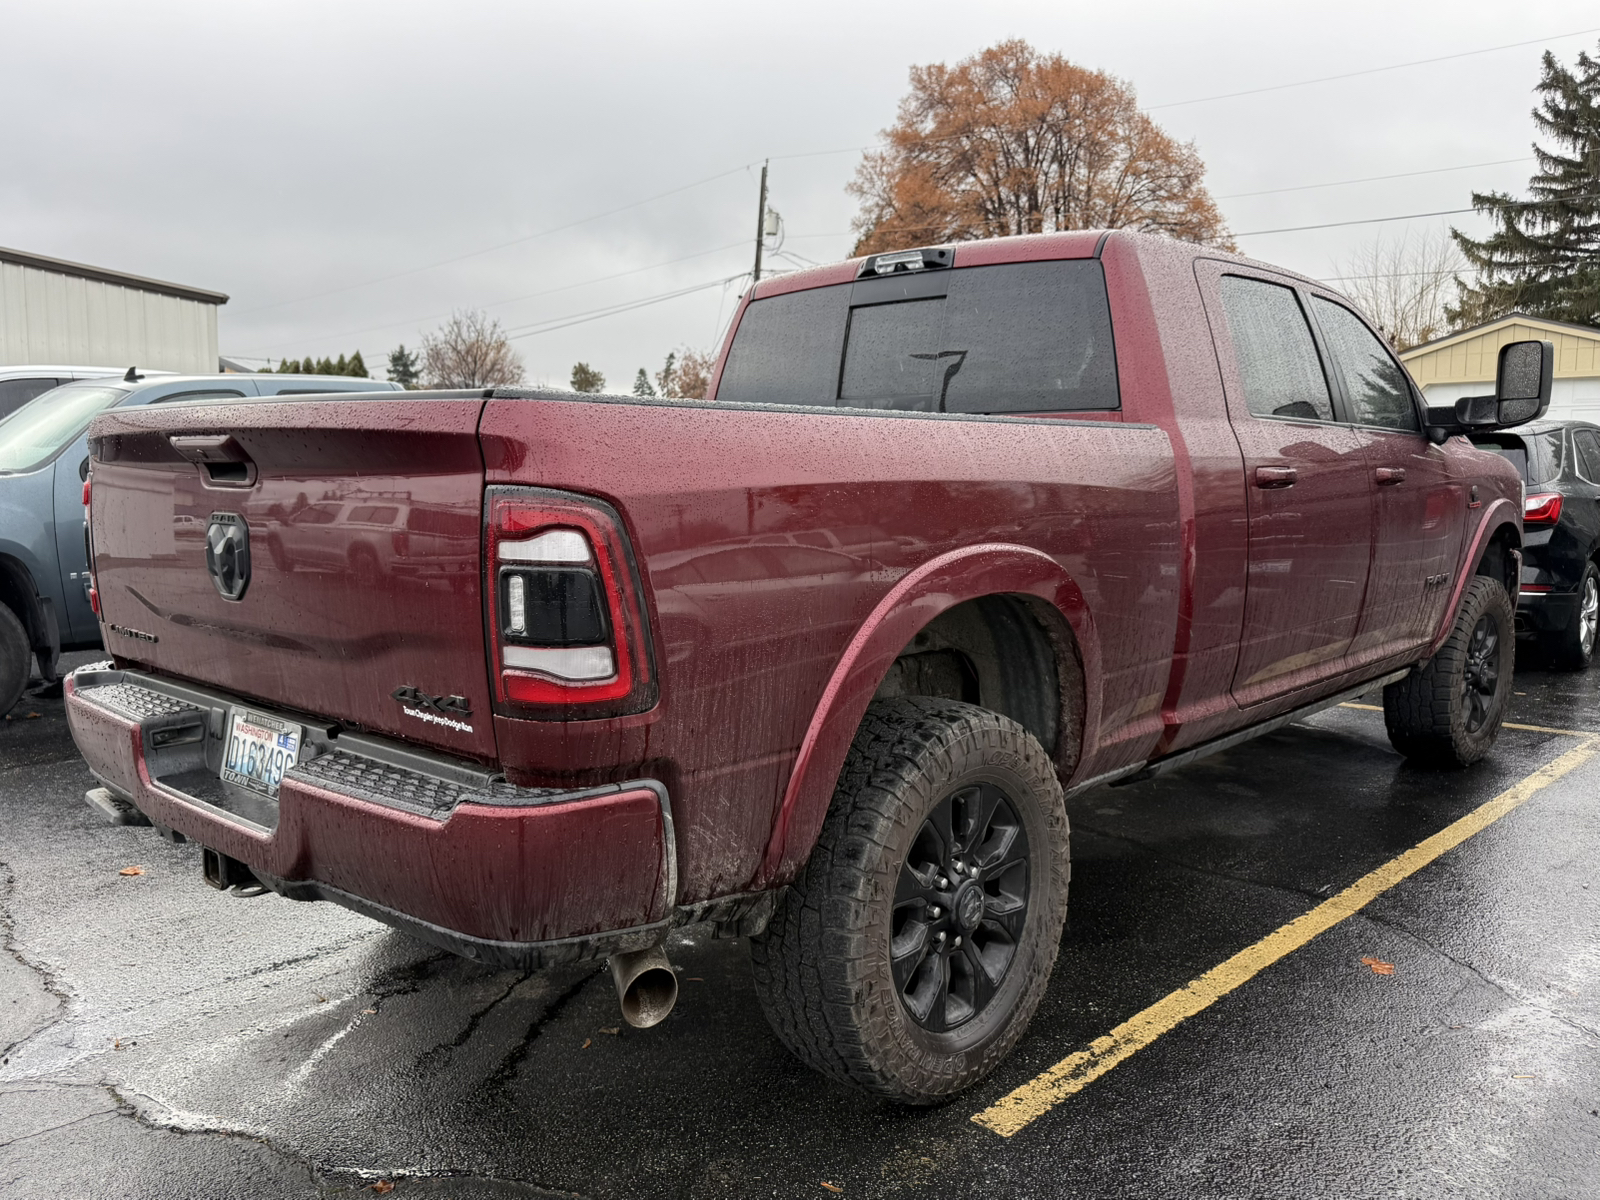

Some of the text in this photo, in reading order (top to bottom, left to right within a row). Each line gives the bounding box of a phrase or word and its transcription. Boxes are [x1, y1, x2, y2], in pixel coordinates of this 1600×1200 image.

[211, 514, 237, 523] RAM
[1425, 572, 1450, 587] RAM
[109, 623, 159, 643] LIMITED
[247, 713, 284, 730] WENATCHEE
[235, 722, 274, 742] WASHINGTON
[986, 751, 1031, 777] OPEN
[224, 771, 250, 786] TOWN
